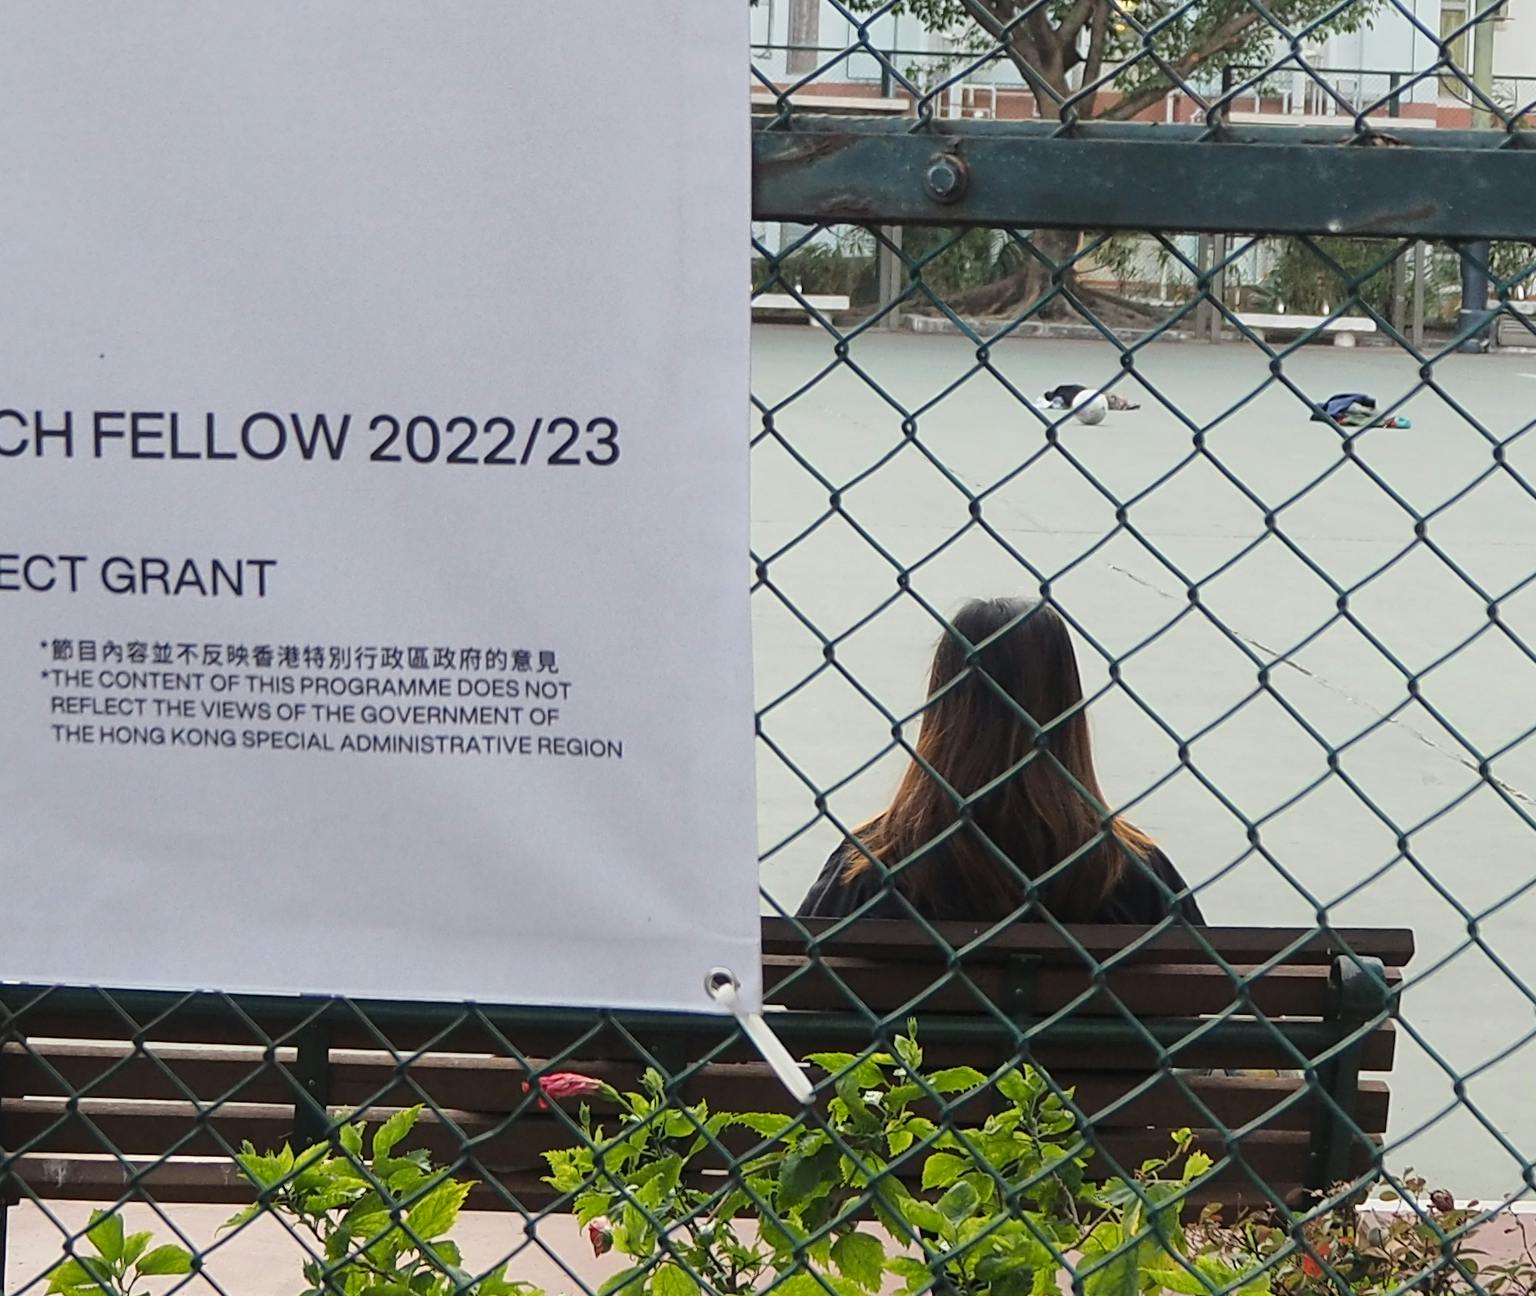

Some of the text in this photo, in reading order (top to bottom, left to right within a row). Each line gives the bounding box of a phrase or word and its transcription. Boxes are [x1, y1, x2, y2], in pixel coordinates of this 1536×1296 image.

[93, 411, 352, 461] FELLOW
[369, 414, 620, 467] 2022/23
[100, 556, 277, 598] GRANT
[98, 670, 205, 691] CONTENT
[209, 673, 240, 693] OF
[244, 674, 295, 695] THIS
[300, 676, 452, 697] PROGRAMME
[457, 677, 520, 698] DOES
[525, 680, 572, 700] NOT
[51, 695, 559, 726] REFLECT THE VIEWS OF THE GOVERNMENT OF
[51, 723, 623, 759] THE HONG KONG SPECIAL ADMINISTRATIVE REGION
